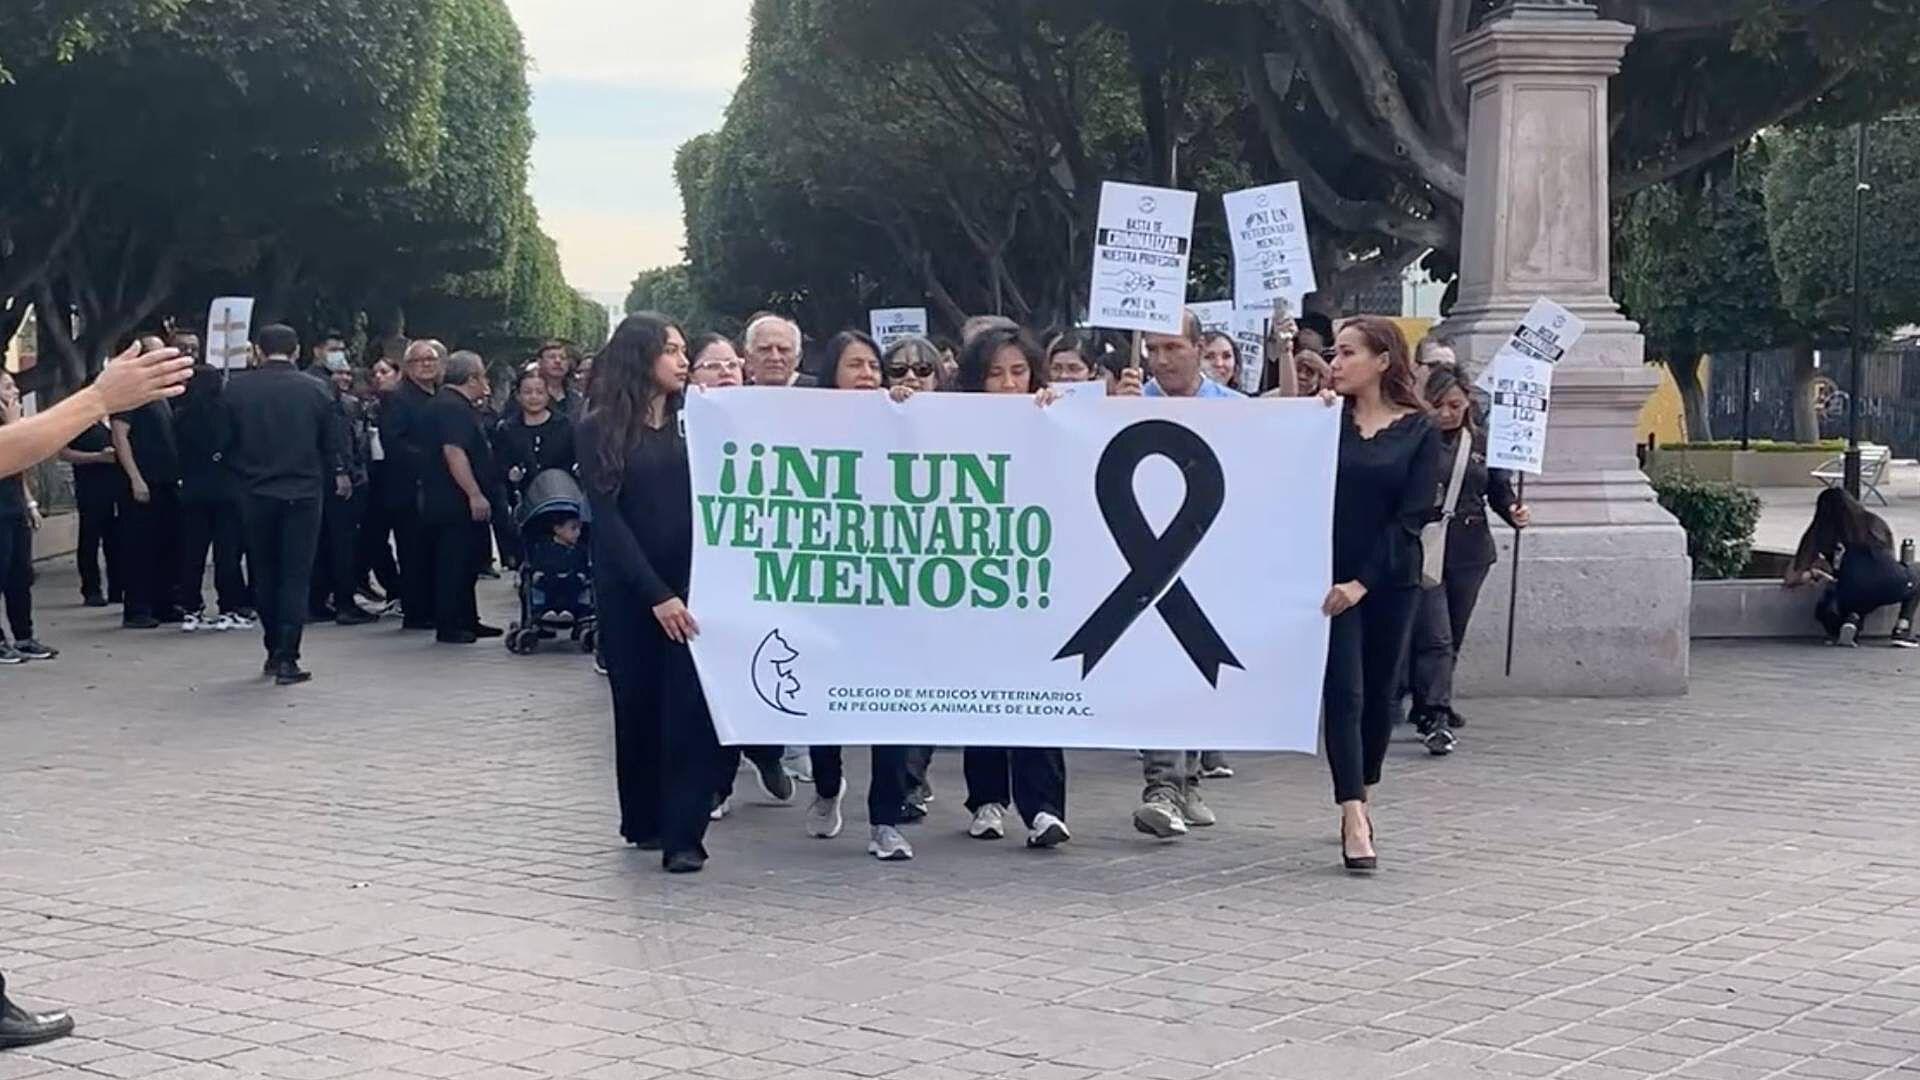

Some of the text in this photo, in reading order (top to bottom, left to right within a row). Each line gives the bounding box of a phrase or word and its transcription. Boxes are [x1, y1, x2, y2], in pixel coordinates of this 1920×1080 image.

[1126, 217, 1163, 234] BASTA DE
[1102, 249, 1137, 263] NUESTRA
[887, 452, 1011, 504] UN
[697, 494, 1053, 558] VETERINARIO
[753, 550, 1051, 610] MENOS!!
[828, 686, 1083, 703] COLEGIO DE MEDICOS VETERINARIOS
[828, 701, 848, 712] EN
[929, 702, 1001, 715] ANIMALES
[1004, 704, 1021, 715] DE
[1026, 705, 1065, 716] LEON
[1067, 706, 1095, 717] A.C.
